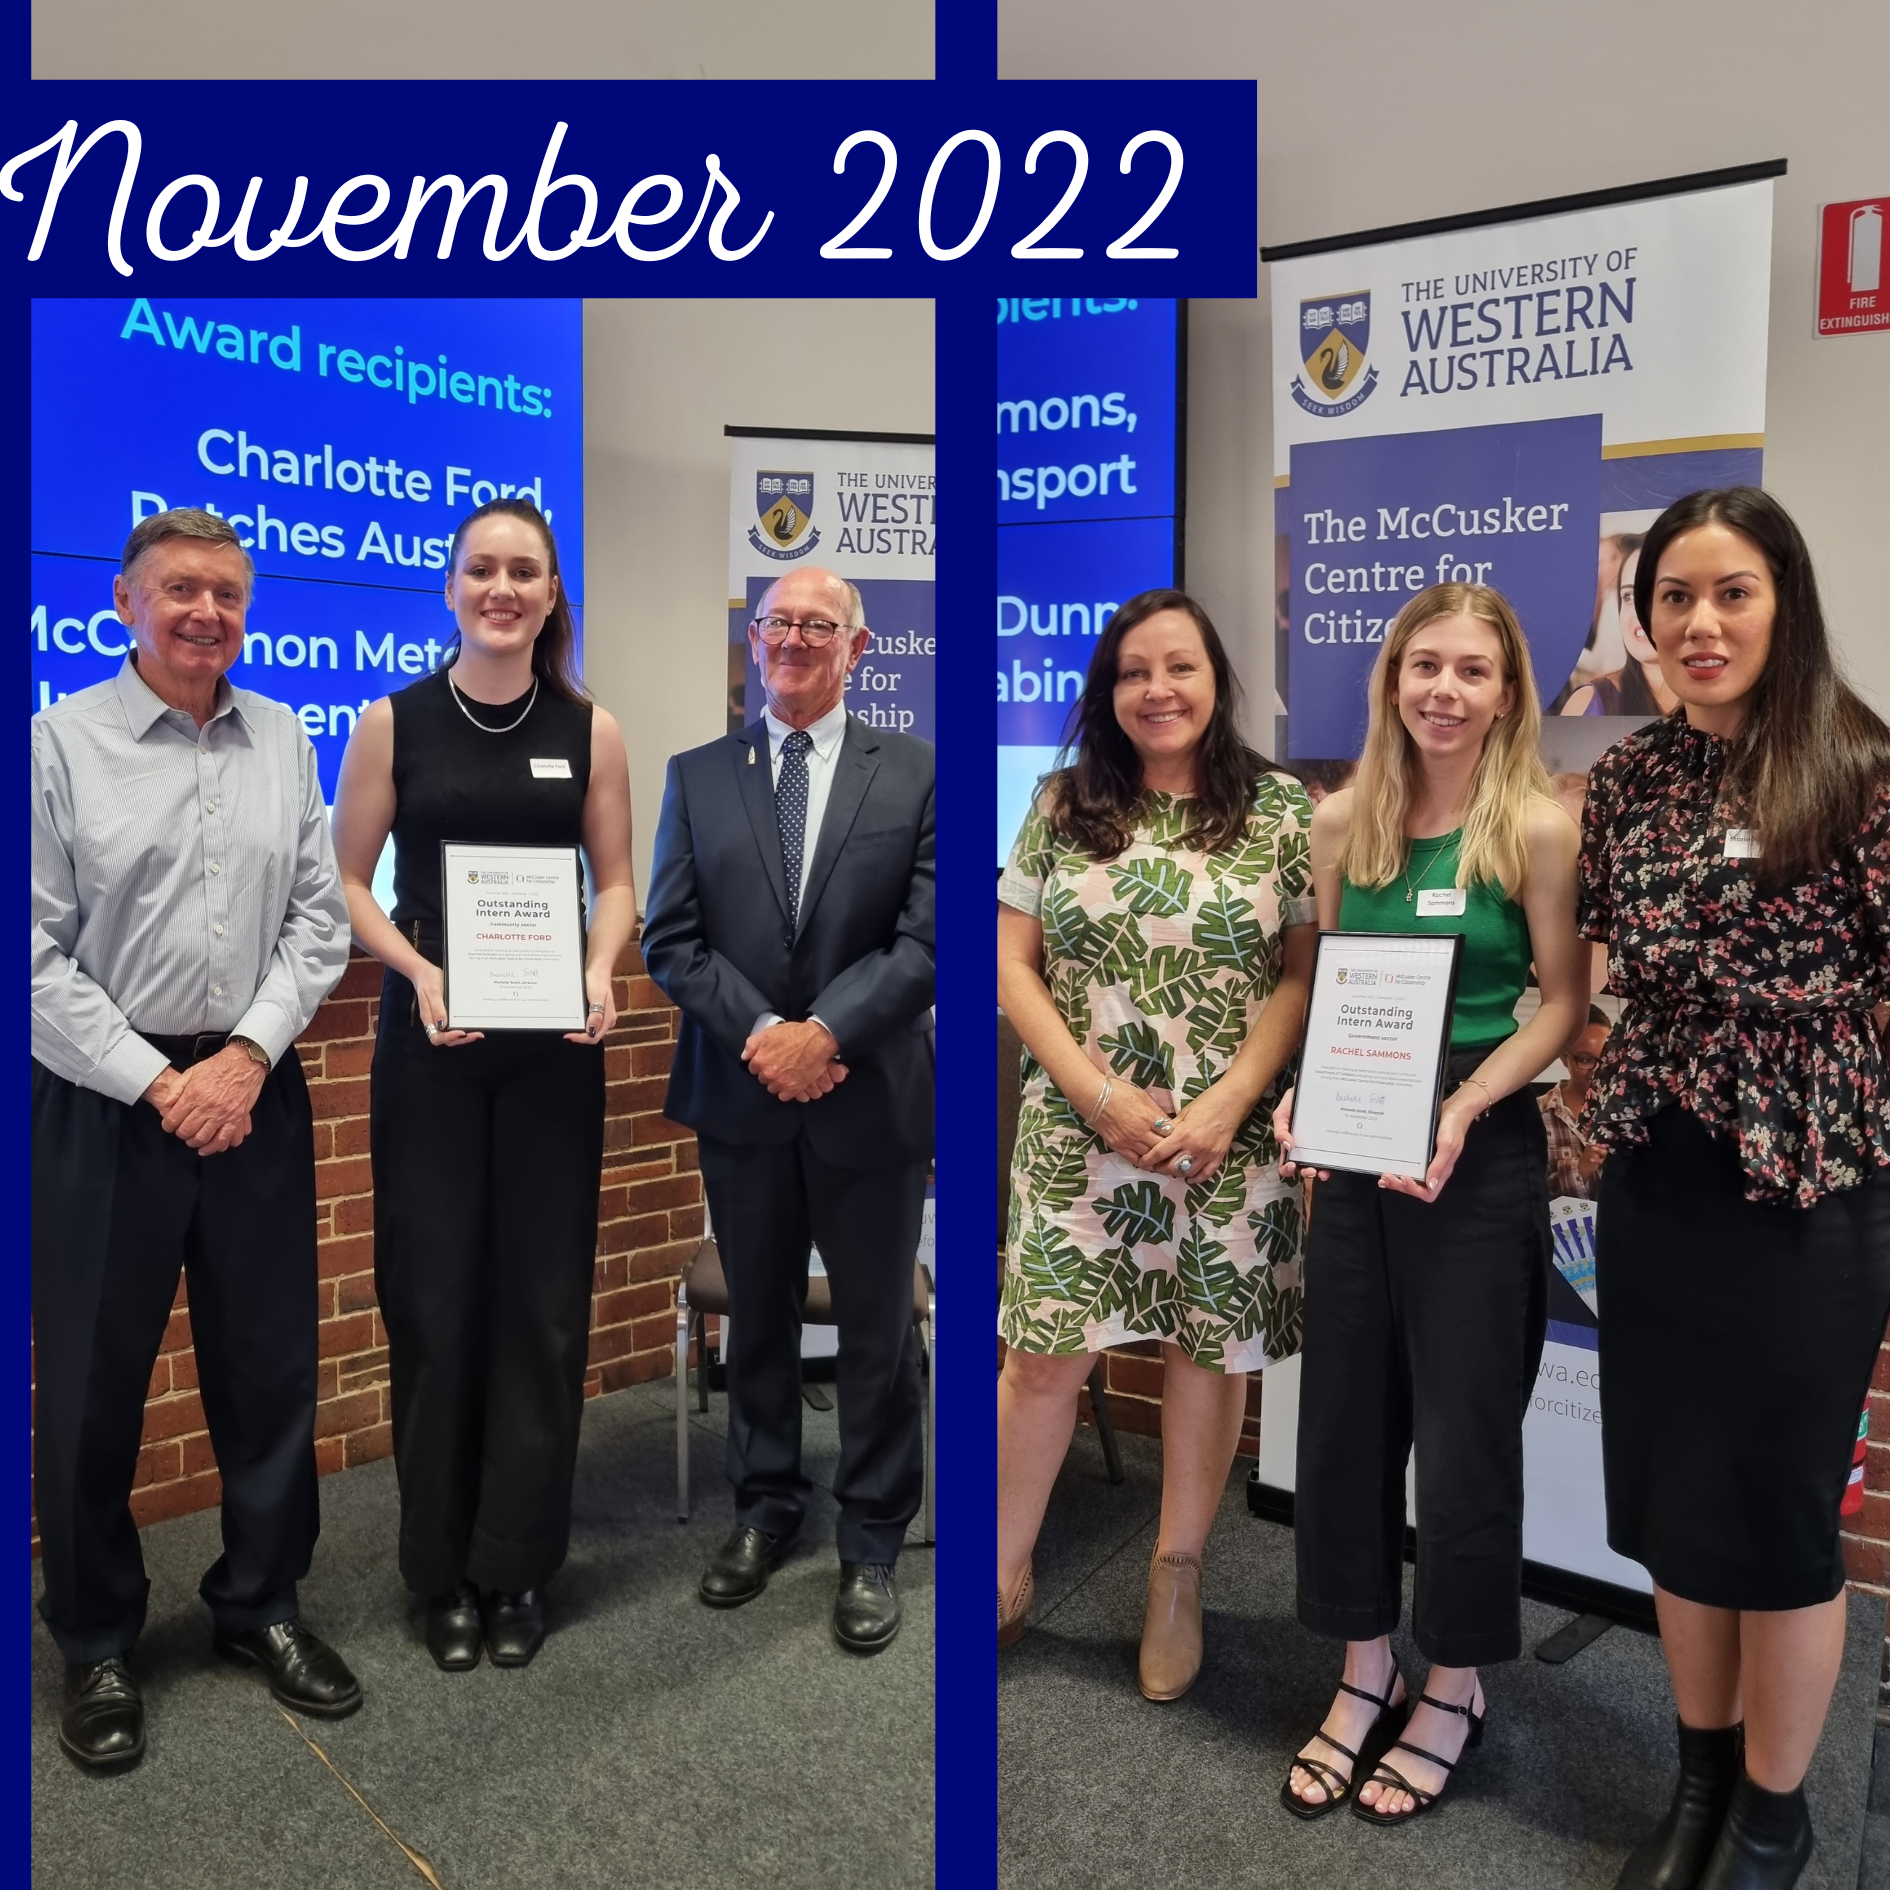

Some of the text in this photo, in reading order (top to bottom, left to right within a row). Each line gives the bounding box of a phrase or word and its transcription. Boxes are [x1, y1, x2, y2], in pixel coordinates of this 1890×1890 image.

[1402, 247, 1637, 303] THE UNIVERSITY OF
[1849, 295, 1877, 310] FIRE
[1401, 277, 1636, 352] WESTERN
[120, 298, 552, 418] Award recipients:
[1400, 333, 1633, 397] AUSTRALIA
[1301, 392, 1365, 415] SEEK WISDOM
[197, 428, 431, 502] Charlotte
[837, 472, 868, 488] THE
[1304, 497, 1569, 544] The McCusker
[758, 544, 810, 559] SEEK WISDOM
[1304, 553, 1492, 595] Centre for
[860, 666, 901, 691] for
[476, 909, 551, 918] Intern Award
[477, 899, 548, 910] Outstanding
[1337, 1016, 1414, 1030] Intern Award
[1341, 1004, 1413, 1020] Outstanding
[1330, 1046, 1412, 1060] RACHEL SAMMONS
